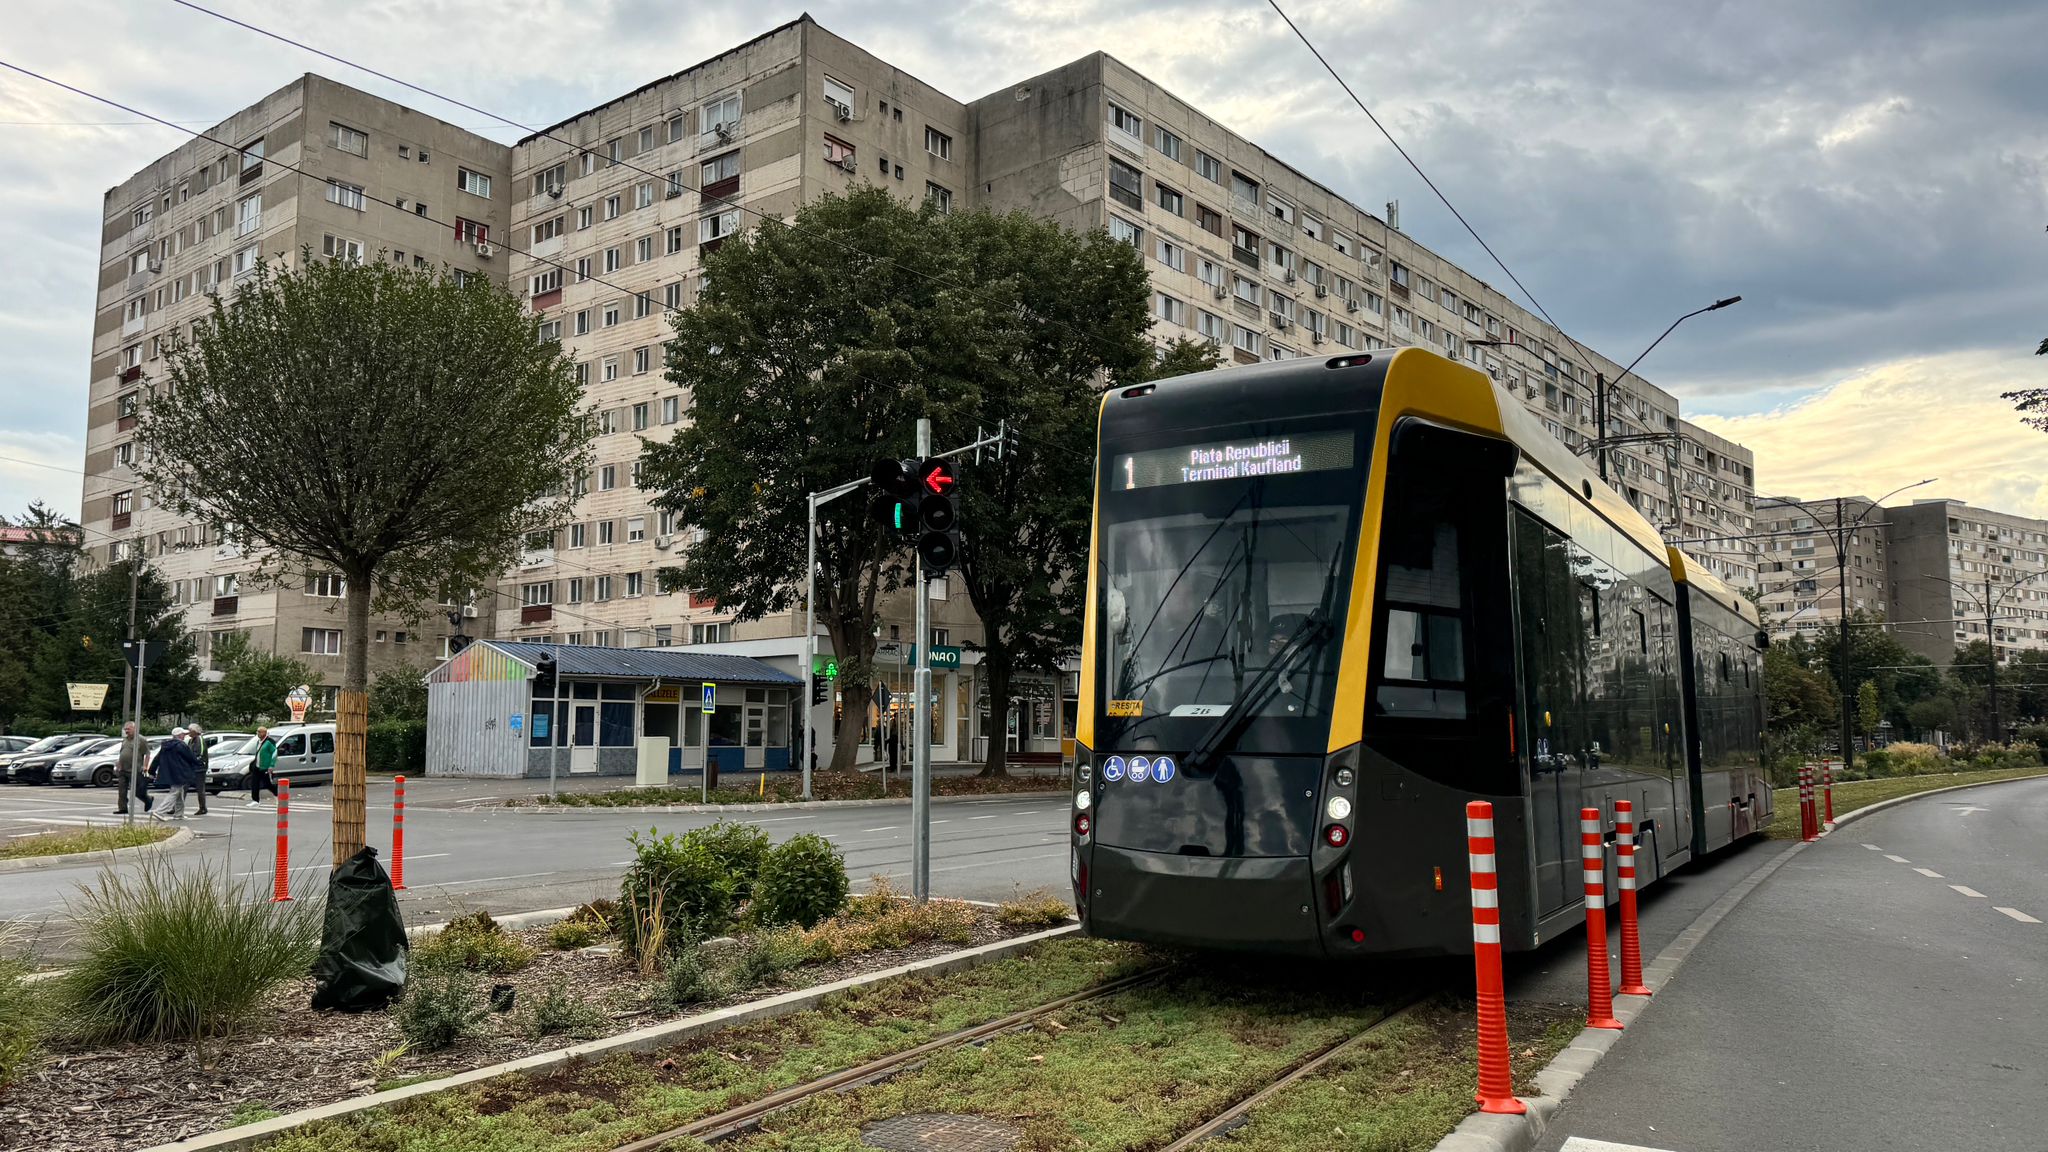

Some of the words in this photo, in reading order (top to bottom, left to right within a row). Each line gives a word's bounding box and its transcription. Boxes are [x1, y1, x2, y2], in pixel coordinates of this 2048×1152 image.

[1191, 448, 1223, 465] Piata
[1225, 439, 1290, 461] Republicii
[1125, 457, 1135, 489] 1
[1181, 462, 1238, 482] Terminal
[1241, 454, 1302, 476] Kaufland
